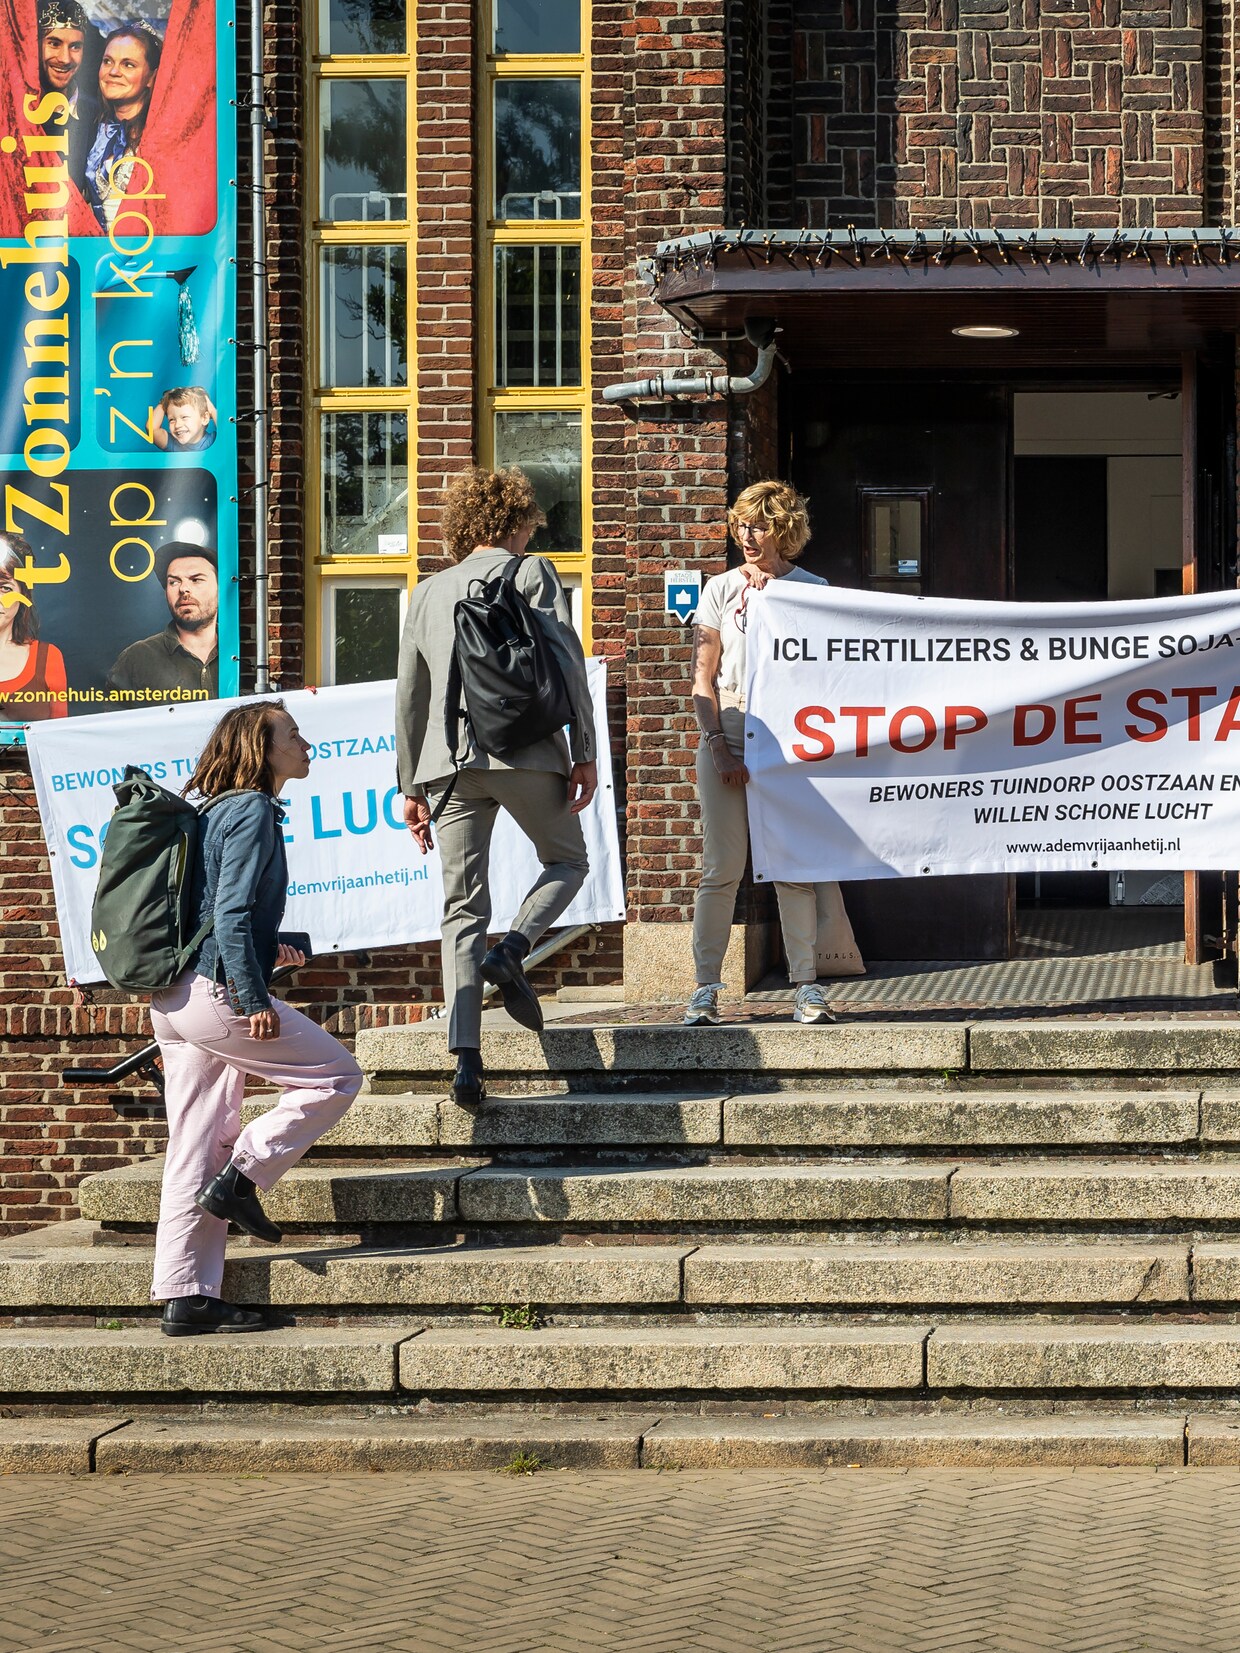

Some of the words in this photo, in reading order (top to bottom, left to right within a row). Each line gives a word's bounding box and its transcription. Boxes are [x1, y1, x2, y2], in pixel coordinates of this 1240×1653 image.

[91, 155, 167, 298] kop
[0, 90, 71, 536] Zonnehuis
[94, 338, 154, 445] z'n
[109, 481, 168, 583] op
[773, 637, 819, 662] ICL
[826, 637, 1012, 662] FERTILIZERS
[1019, 637, 1041, 662] &
[1048, 635, 1150, 661] BUNGE
[791, 704, 989, 763] STOP
[1012, 693, 1104, 747] DE
[51, 761, 167, 793] BEWONRS
[868, 779, 986, 804] BEWONERS
[989, 775, 1096, 796] TUINDORP
[1100, 773, 1215, 792] OOSTZAAN
[974, 804, 1050, 825] WILLEN
[1055, 802, 1141, 823] SCHONE
[1145, 802, 1214, 820] LUCHT
[1005, 837, 1181, 858] www.ademvrijaanhetij.nl
[287, 864, 429, 897] demvrijaanhetij.nl
